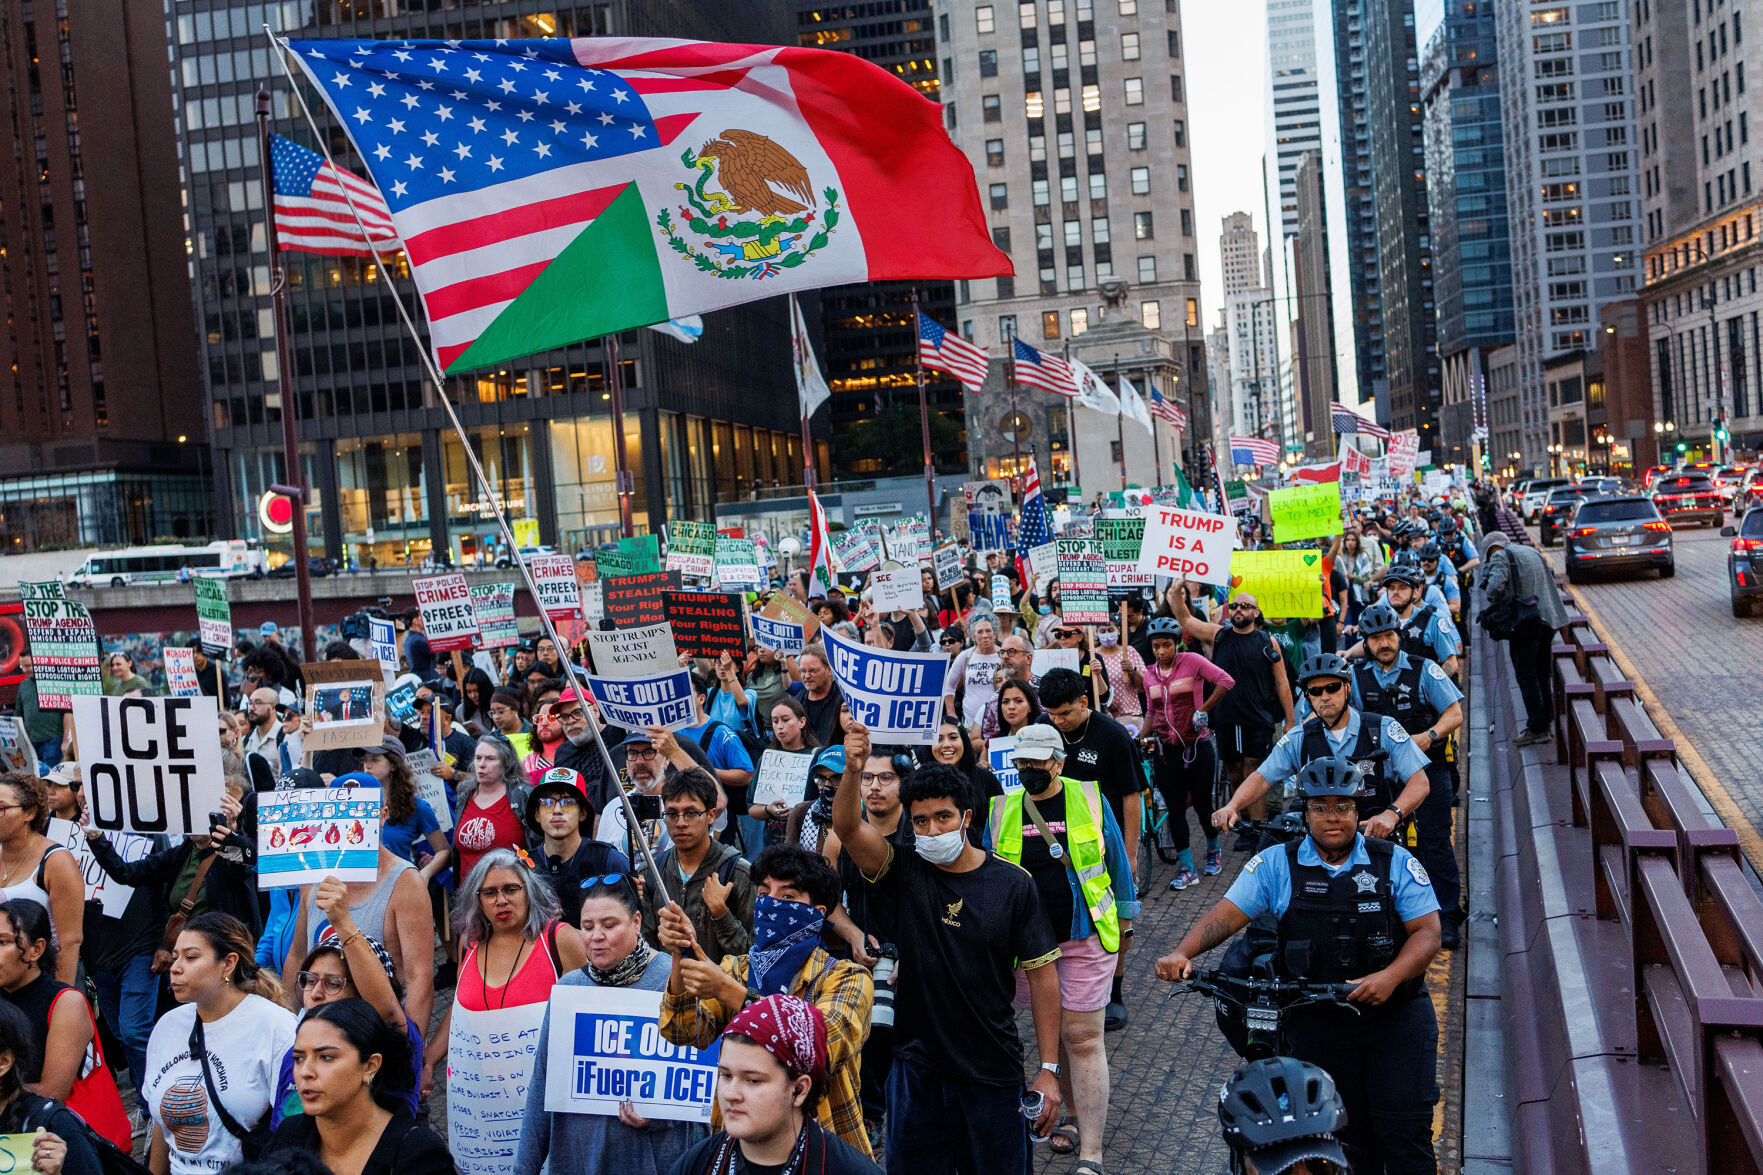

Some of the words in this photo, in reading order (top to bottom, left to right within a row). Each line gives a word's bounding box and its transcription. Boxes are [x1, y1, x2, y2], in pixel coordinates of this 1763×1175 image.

[1160, 511, 1225, 533] TRUMP
[671, 528, 715, 540] CHICAGO
[1096, 528, 1144, 541] CHICAG
[669, 544, 713, 556] PALESTINE
[715, 543, 753, 553] CHICAGO
[1058, 540, 1086, 554] STOP
[1089, 541, 1103, 554] THE
[1168, 535, 1186, 550] IS
[1190, 539, 1204, 554] A
[550, 557, 571, 565] POLICE
[596, 556, 632, 570] CHICAGO
[668, 555, 711, 565] OCCUPATION
[1157, 555, 1209, 576] PEDO
[534, 564, 574, 579] CRIMES
[875, 573, 892, 583] ICE
[1110, 575, 1117, 583] A
[1121, 574, 1152, 583] CRIME!
[415, 581, 433, 590] STOP
[436, 576, 465, 588] POLICE
[609, 572, 670, 587] TRUMP'S
[38, 582, 63, 600] THE
[417, 584, 468, 604] CRIMES
[470, 585, 496, 598] STOP
[496, 583, 513, 594] THE
[545, 581, 569, 595] FREE
[608, 585, 676, 600] STEALING
[563, 594, 579, 603] ALL
[669, 593, 729, 603] TRUMP'S
[26, 601, 59, 618] STOP
[62, 601, 89, 618] THE
[431, 605, 463, 621] FREE
[607, 603, 635, 613] Your
[639, 600, 664, 612] Rig
[669, 606, 737, 617] STEALING
[28, 618, 53, 628] TRUMP
[55, 618, 92, 628] AGENDA!
[425, 621, 452, 635] THEM
[456, 619, 477, 630] ALL
[669, 619, 696, 629] Your
[700, 620, 740, 632] Rights
[758, 619, 772, 634] ICE
[773, 622, 795, 638] OUT!
[28, 628, 54, 636] DEFEND
[65, 628, 96, 636] EXPAND
[593, 631, 620, 643] STOP
[620, 626, 666, 642] TRUMP'S
[672, 632, 698, 642] Your
[700, 634, 742, 645] Money
[612, 641, 649, 653] RACIST
[784, 639, 803, 650] ICE!
[165, 648, 192, 659] NOBODY
[380, 646, 396, 662] ICE!
[612, 651, 657, 664] AGENDA!
[702, 647, 744, 658] Heath
[32, 657, 49, 665] STOP
[51, 657, 71, 665] POLICE
[73, 657, 99, 665] CRIMES
[174, 658, 181, 667] IS
[34, 665, 56, 673] DEFEND
[56, 665, 85, 673] LGBTQIA+
[86, 665, 101, 673] AND
[167, 665, 195, 675] ILLEGAL
[832, 642, 861, 685] ICE
[864, 659, 925, 695] OUT!
[169, 680, 198, 689] STOLEN
[602, 683, 631, 704] ICE
[632, 678, 676, 705] OUT!
[39, 694, 60, 702] DEFEND
[40, 700, 71, 709] ACADEMIC
[386, 686, 416, 713] ICE
[657, 699, 691, 726] ICE!
[887, 699, 936, 730] ICE!
[100, 697, 195, 760] ICE
[763, 751, 785, 768] FUCK
[790, 756, 809, 769] ICE
[760, 769, 781, 780] FUCK
[274, 788, 316, 805] MELT
[325, 786, 353, 801] ICE!
[757, 782, 776, 796] FUCK
[90, 762, 197, 834] OUT
[488, 1031, 511, 1044] BE
[518, 1027, 539, 1039] AT
[593, 1019, 634, 1055] ICE
[467, 1044, 537, 1061] READING,
[210, 1053, 229, 1092] HORCHATA
[463, 1071, 480, 1082] ICE
[485, 1074, 505, 1082] IS
[510, 1069, 524, 1079] ON
[663, 1065, 713, 1104] ICE!
[480, 1108, 526, 1119] SNATCHI
